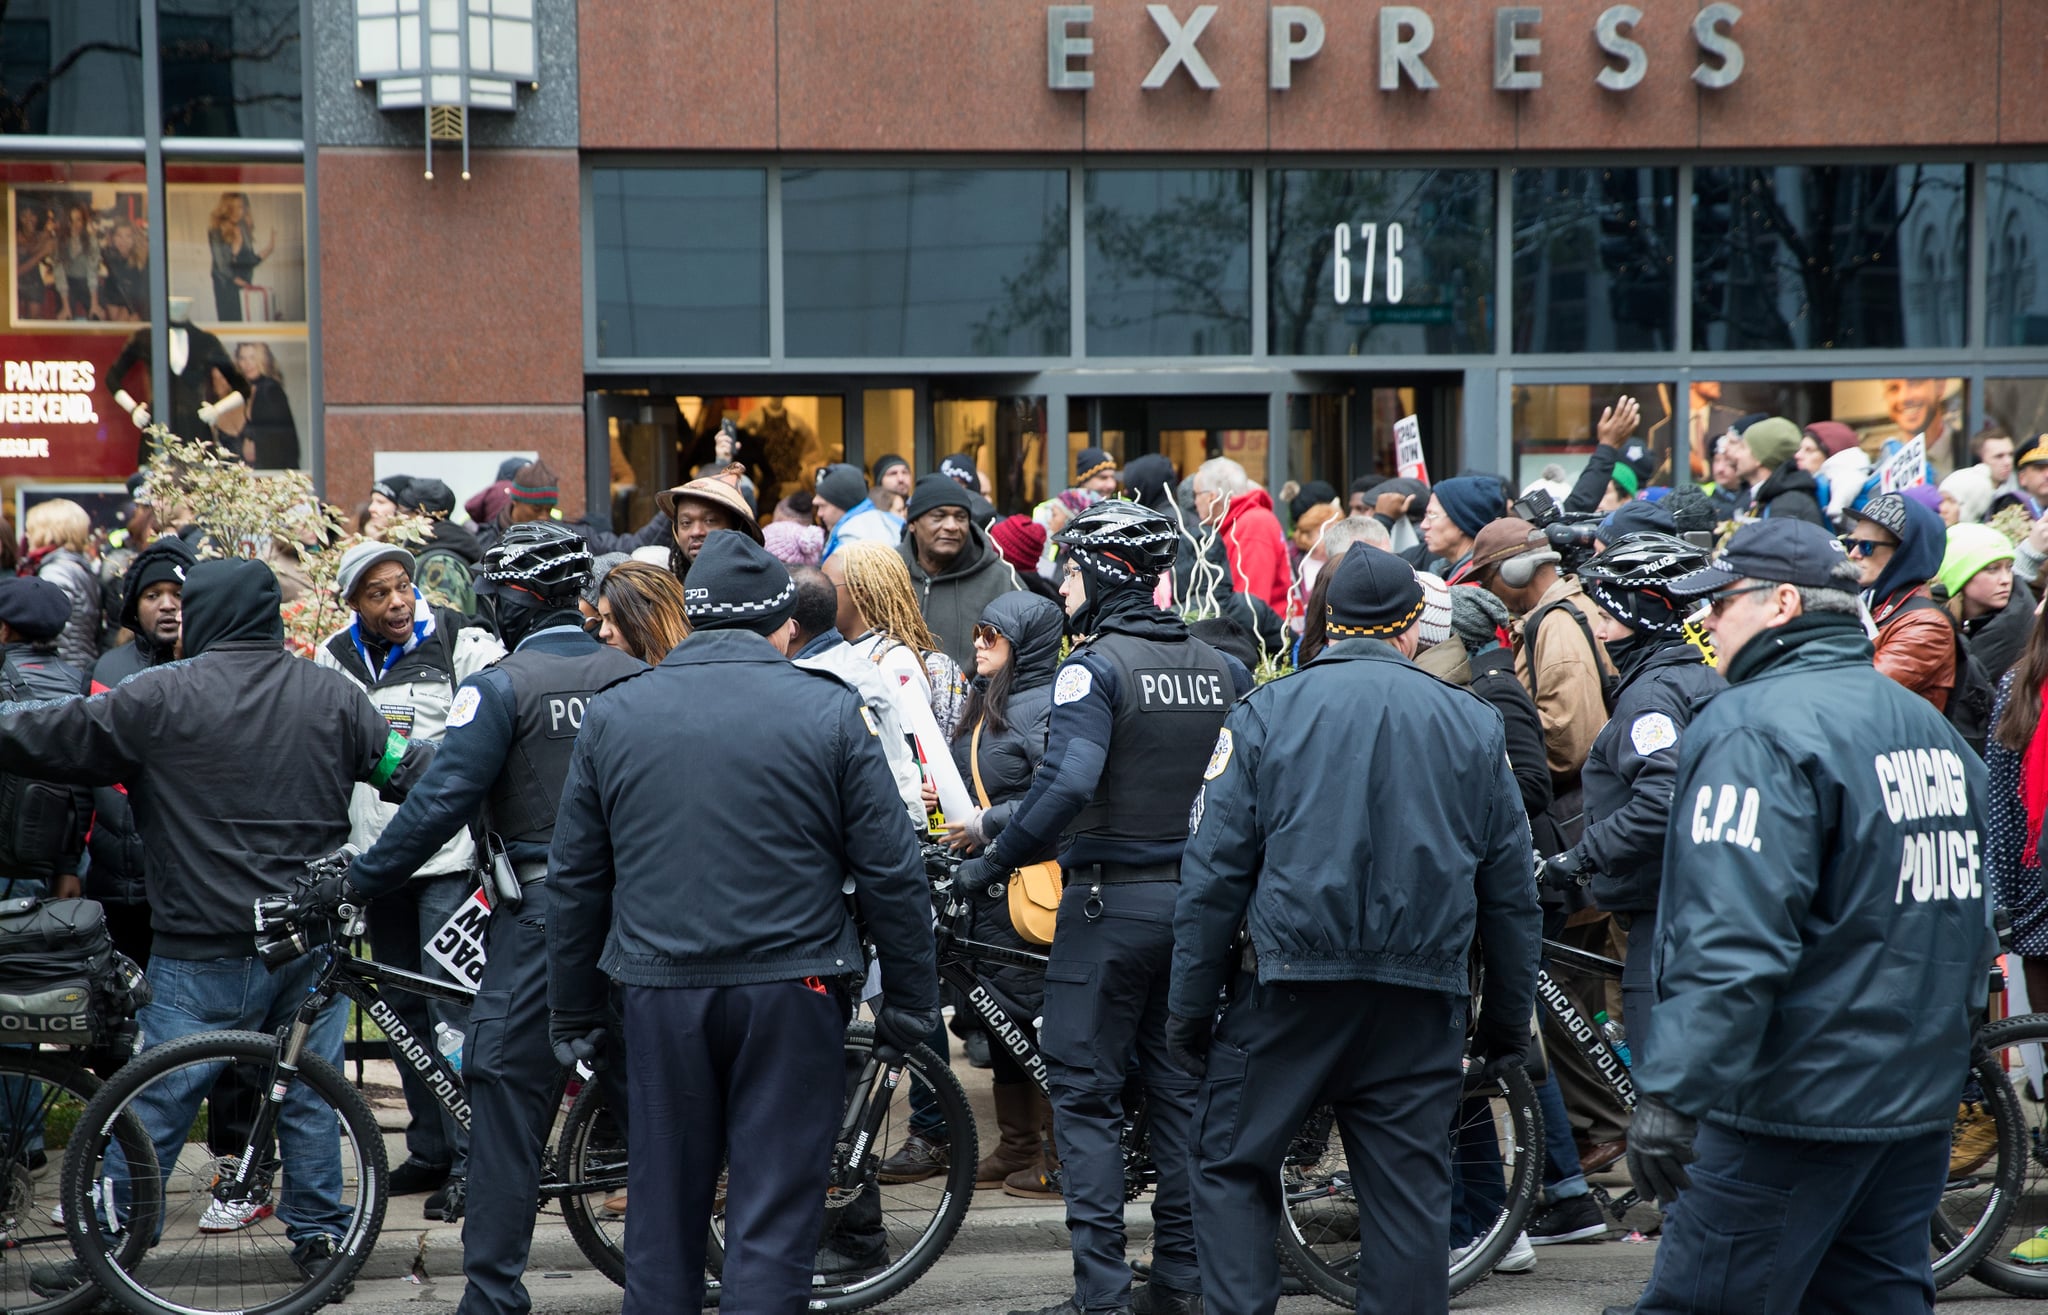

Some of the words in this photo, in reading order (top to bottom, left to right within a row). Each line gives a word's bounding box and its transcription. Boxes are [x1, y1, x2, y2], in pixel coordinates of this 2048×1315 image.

[1047, 2, 1745, 92] EXPRESS
[1334, 222, 1403, 304] 676
[4, 360, 96, 392] PARTIES
[499, 546, 525, 569] POLICE
[1643, 554, 1678, 575] POLICE
[549, 697, 591, 731] PO
[1140, 673, 1224, 706] POLICE
[1691, 784, 1762, 853] C.P.D.
[1895, 829, 1983, 905] POLICE
[433, 926, 485, 985] PAC
[0, 1014, 88, 1031] OLICE
[969, 985, 1030, 1056] CHICAGO
[1024, 1054, 1051, 1095] POL
[1535, 969, 1593, 1043] CHICAGO
[1588, 1041, 1638, 1105] POLICE
[369, 1000, 432, 1071] CHICAGO
[426, 1069, 472, 1131] POLICE
[849, 1130, 869, 1169] ROCKSHOX
[1520, 1116, 1537, 1200] BONTRAGER
